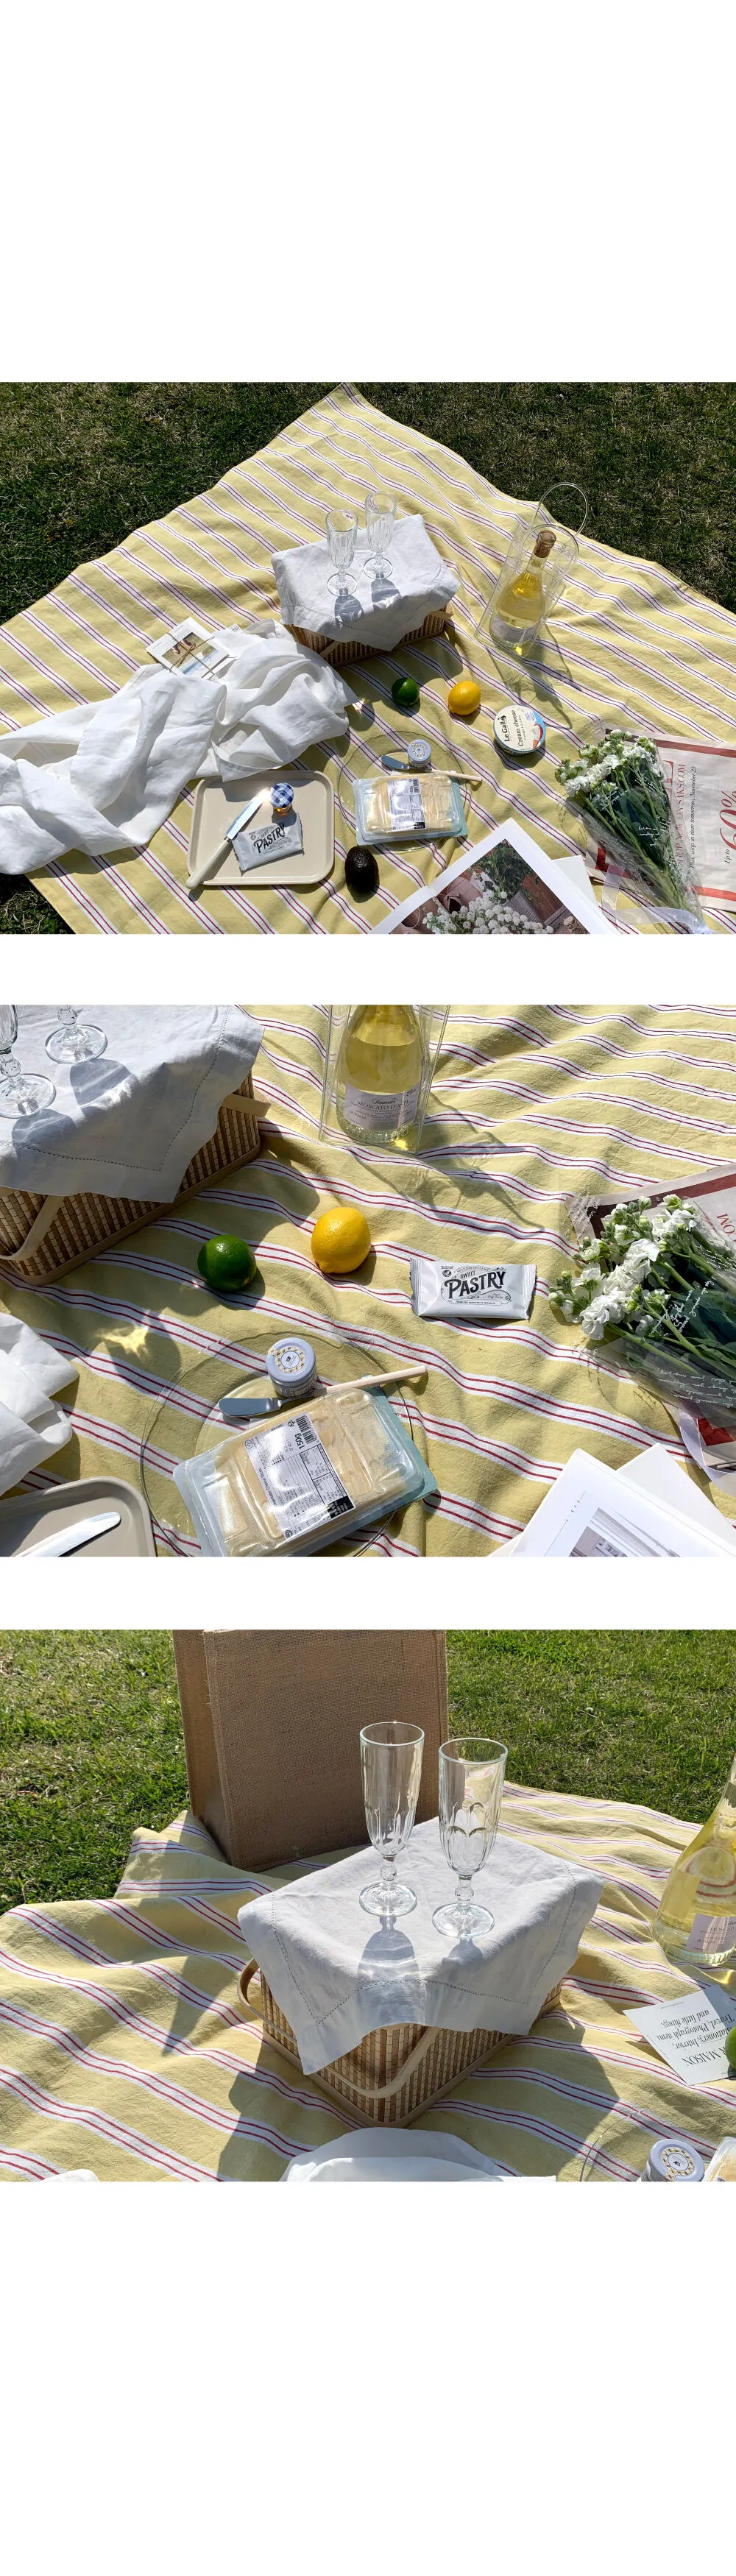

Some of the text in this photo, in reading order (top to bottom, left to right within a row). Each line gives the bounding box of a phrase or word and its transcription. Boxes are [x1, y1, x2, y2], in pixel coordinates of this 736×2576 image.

[500, 721, 510, 742] Le Gall
[516, 729, 524, 747] Cream
[253, 824, 286, 854] PASTRY
[358, 1100, 389, 1111] MOSCATO
[460, 1270, 476, 1279] SWEET
[445, 1271, 506, 1299] PASTRY
[294, 1432, 305, 1450] 150g
[657, 2014, 735, 2041] Travel, Photograph items
[660, 2009, 710, 2028] and little things.
[672, 2039, 698, 2050] Interior,
[682, 2050, 721, 2066] MAISON
